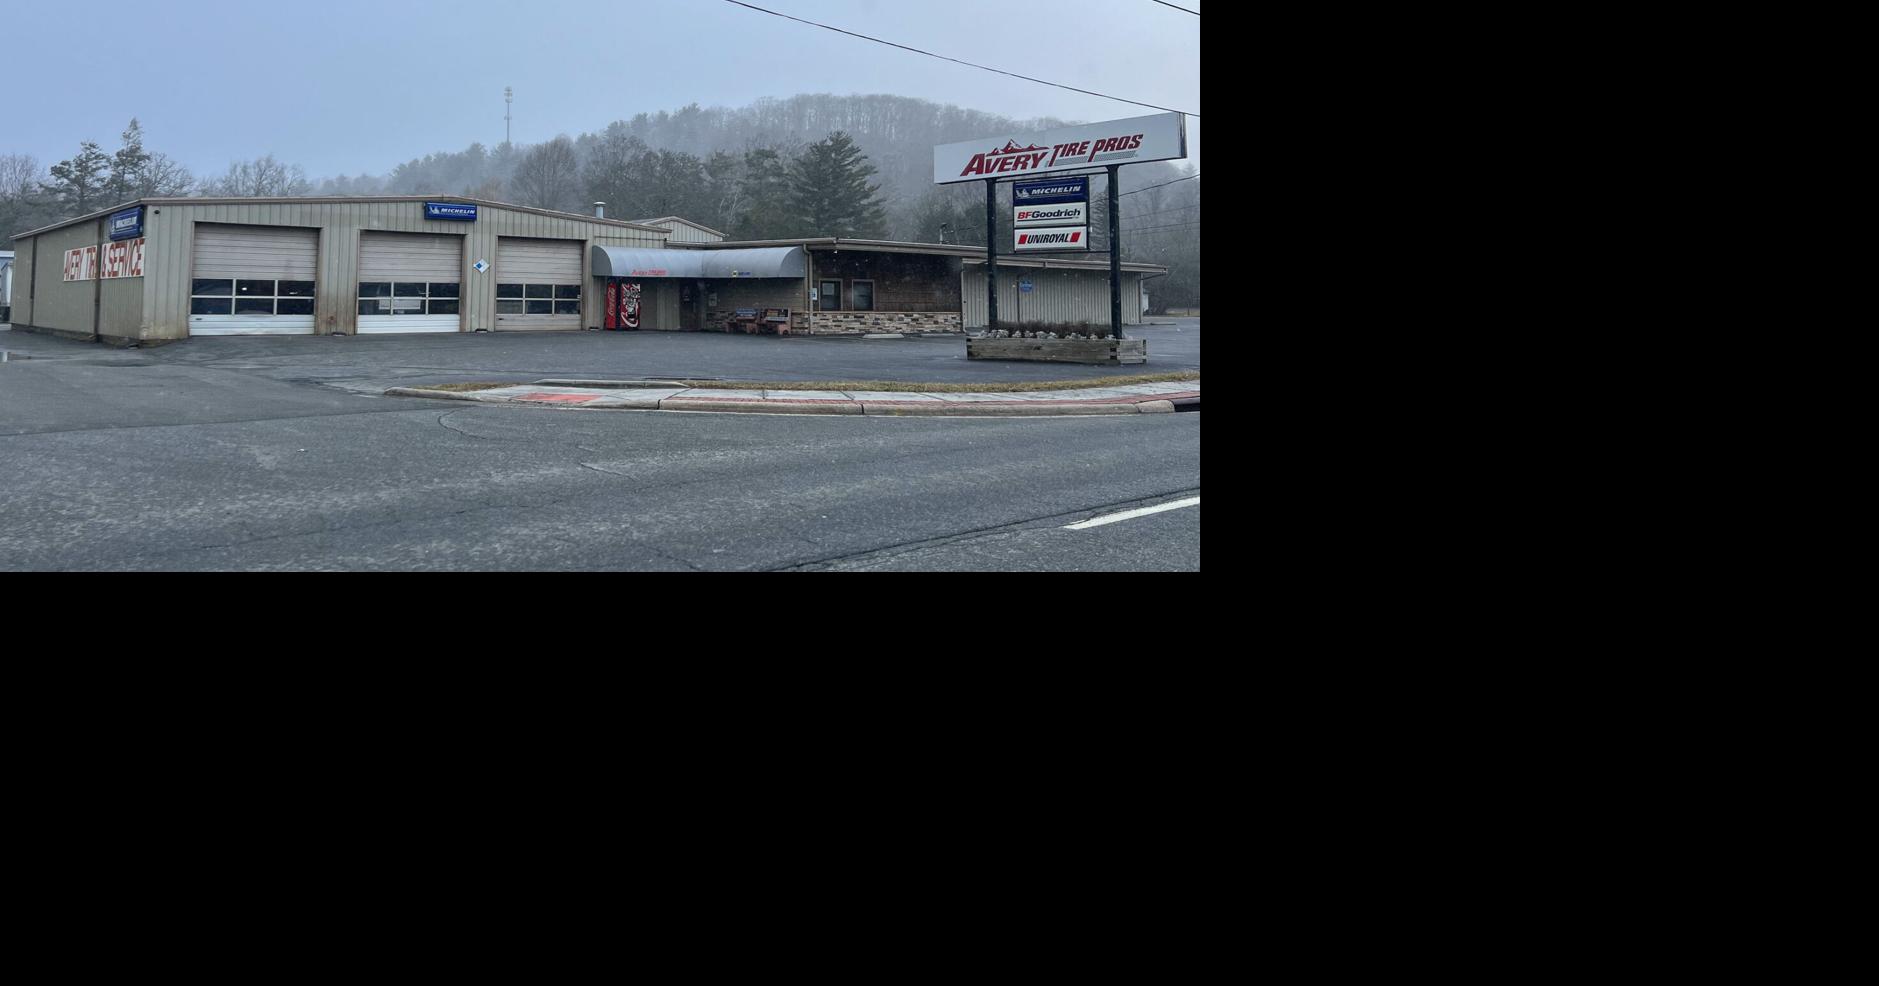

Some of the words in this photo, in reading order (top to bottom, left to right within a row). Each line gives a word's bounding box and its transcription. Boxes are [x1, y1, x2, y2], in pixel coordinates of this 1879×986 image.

[960, 151, 1048, 176] AVERY
[1048, 141, 1091, 167] TIRE
[1087, 134, 1144, 162] PROS
[1031, 185, 1081, 195] MICHELIN
[1017, 208, 1081, 220] BFGoodrich
[1027, 233, 1070, 245] UNIROYAL
[108, 238, 145, 277] SERVICE
